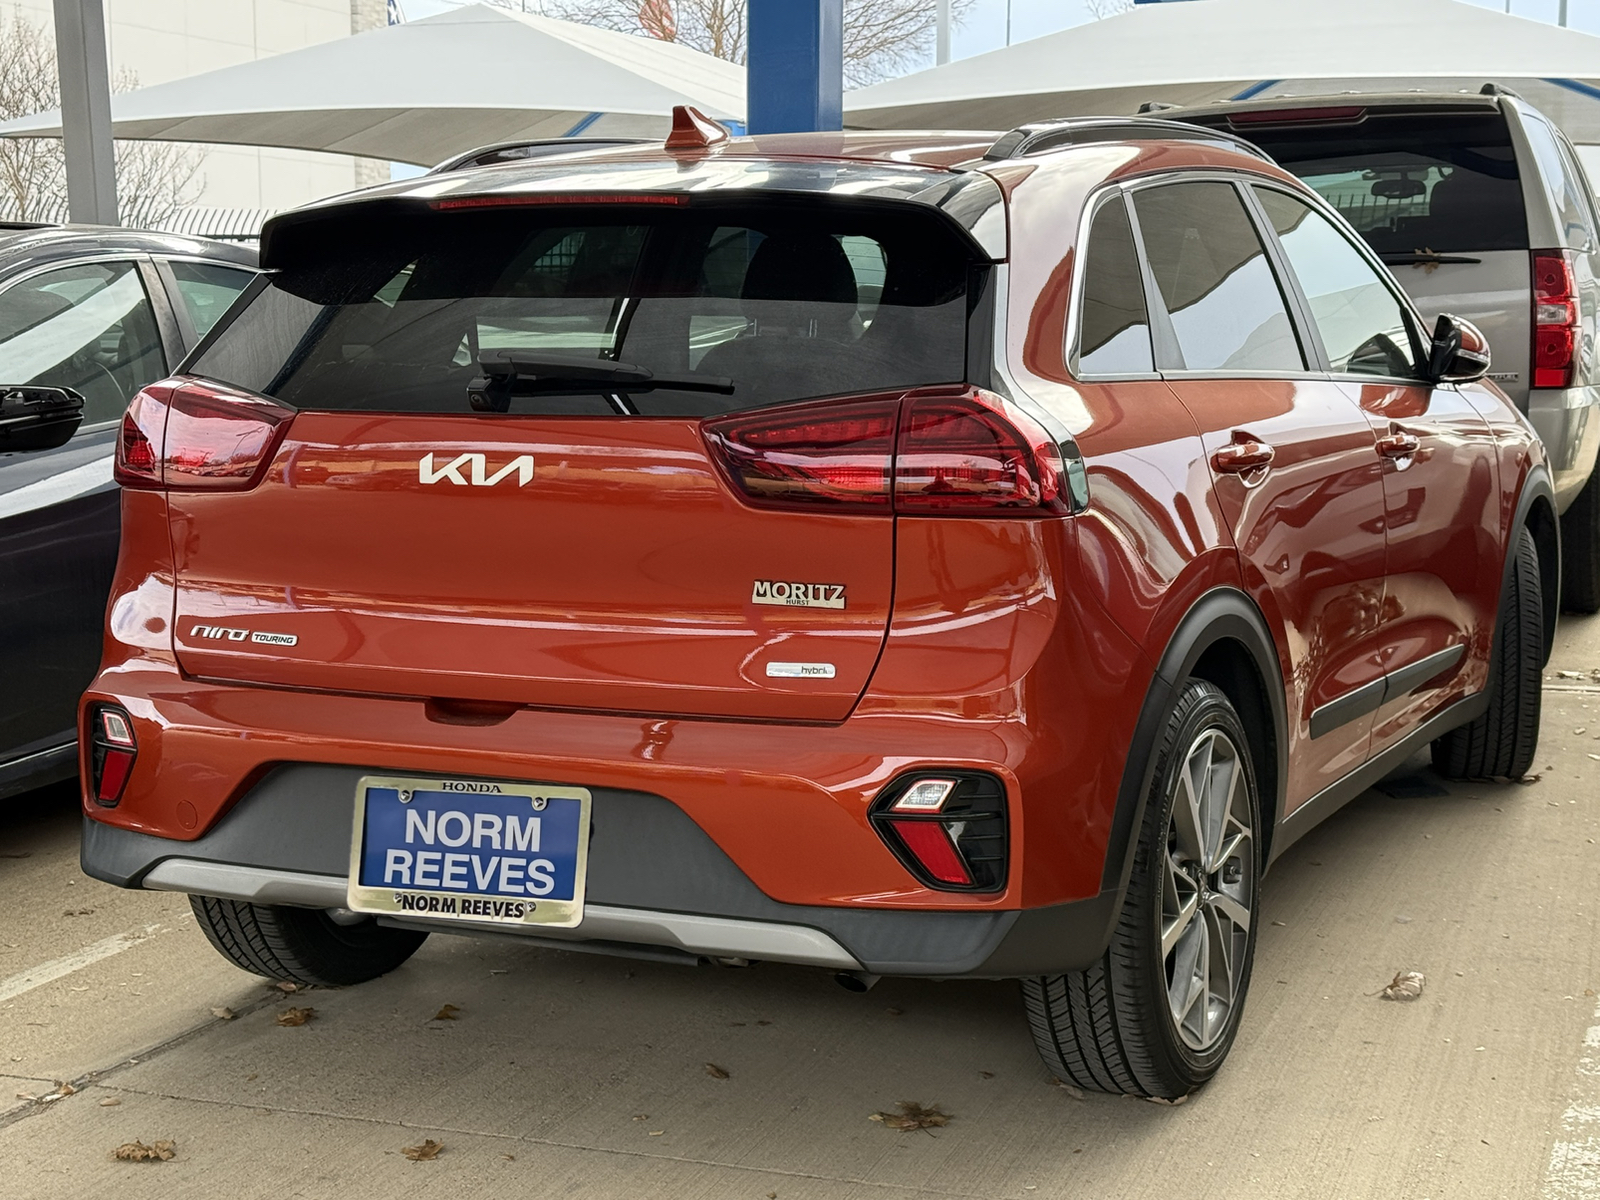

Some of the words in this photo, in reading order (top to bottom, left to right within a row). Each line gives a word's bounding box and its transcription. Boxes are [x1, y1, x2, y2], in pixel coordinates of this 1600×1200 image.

[753, 580, 846, 602] MORITZ
[254, 633, 294, 644] TOURING
[442, 782, 502, 794] HONDA
[405, 809, 541, 852] NORM
[384, 849, 555, 896] REEVES
[402, 895, 457, 914] NORM
[461, 899, 524, 918] REEVES
